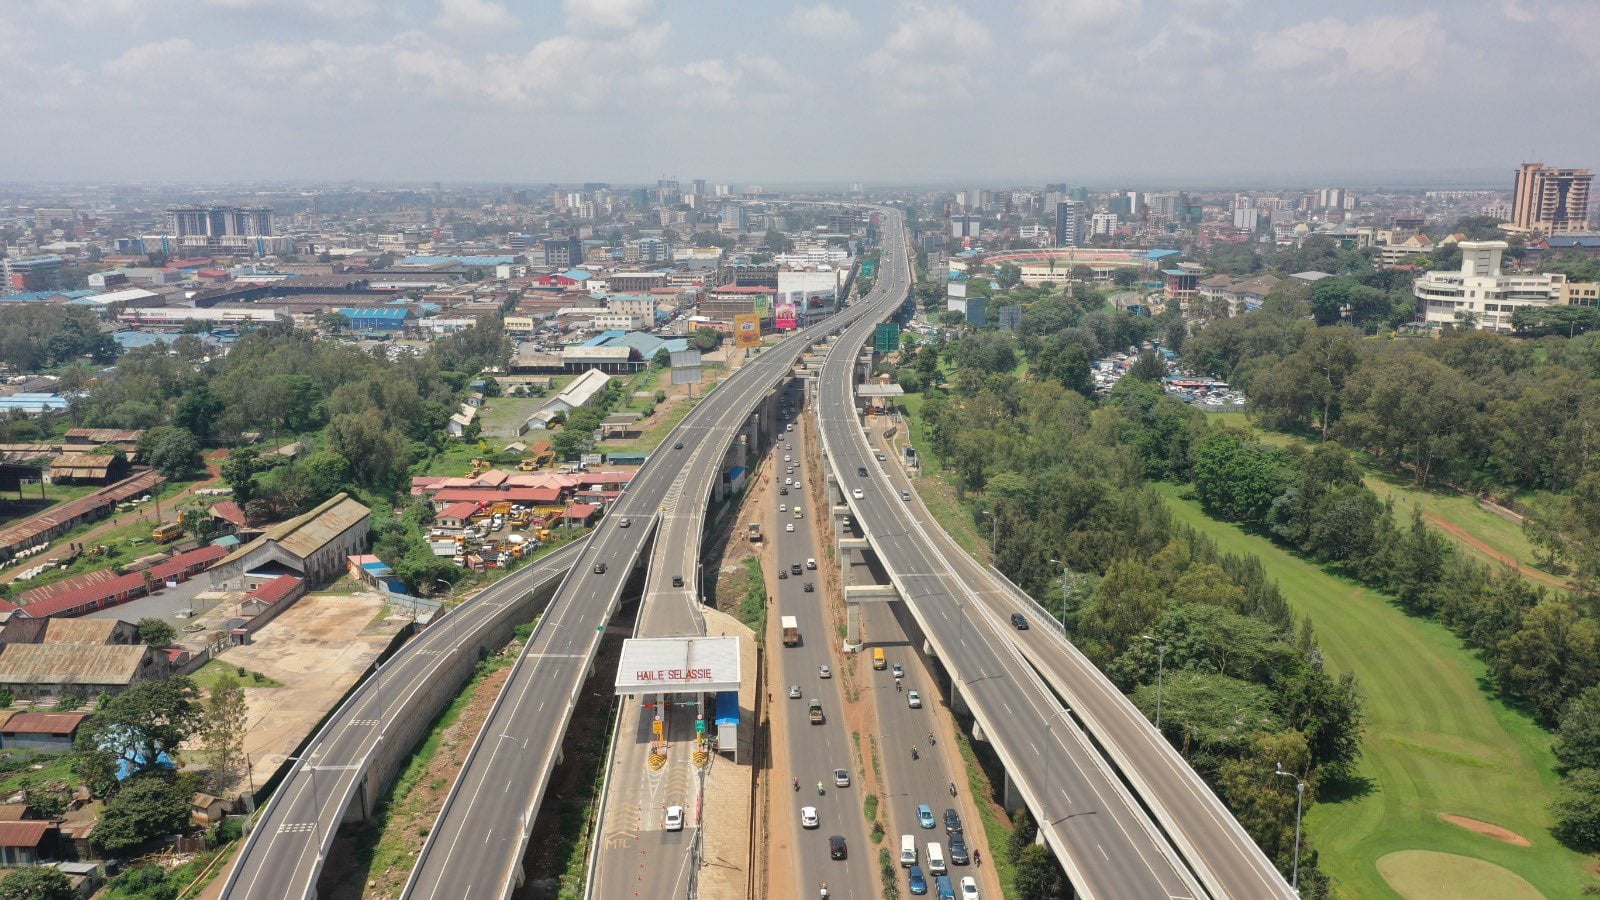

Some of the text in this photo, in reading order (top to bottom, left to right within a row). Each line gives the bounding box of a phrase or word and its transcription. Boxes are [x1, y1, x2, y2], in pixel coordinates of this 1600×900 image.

[636, 669, 712, 680] HAILE SELASSIE
[605, 838, 631, 850] MTC
